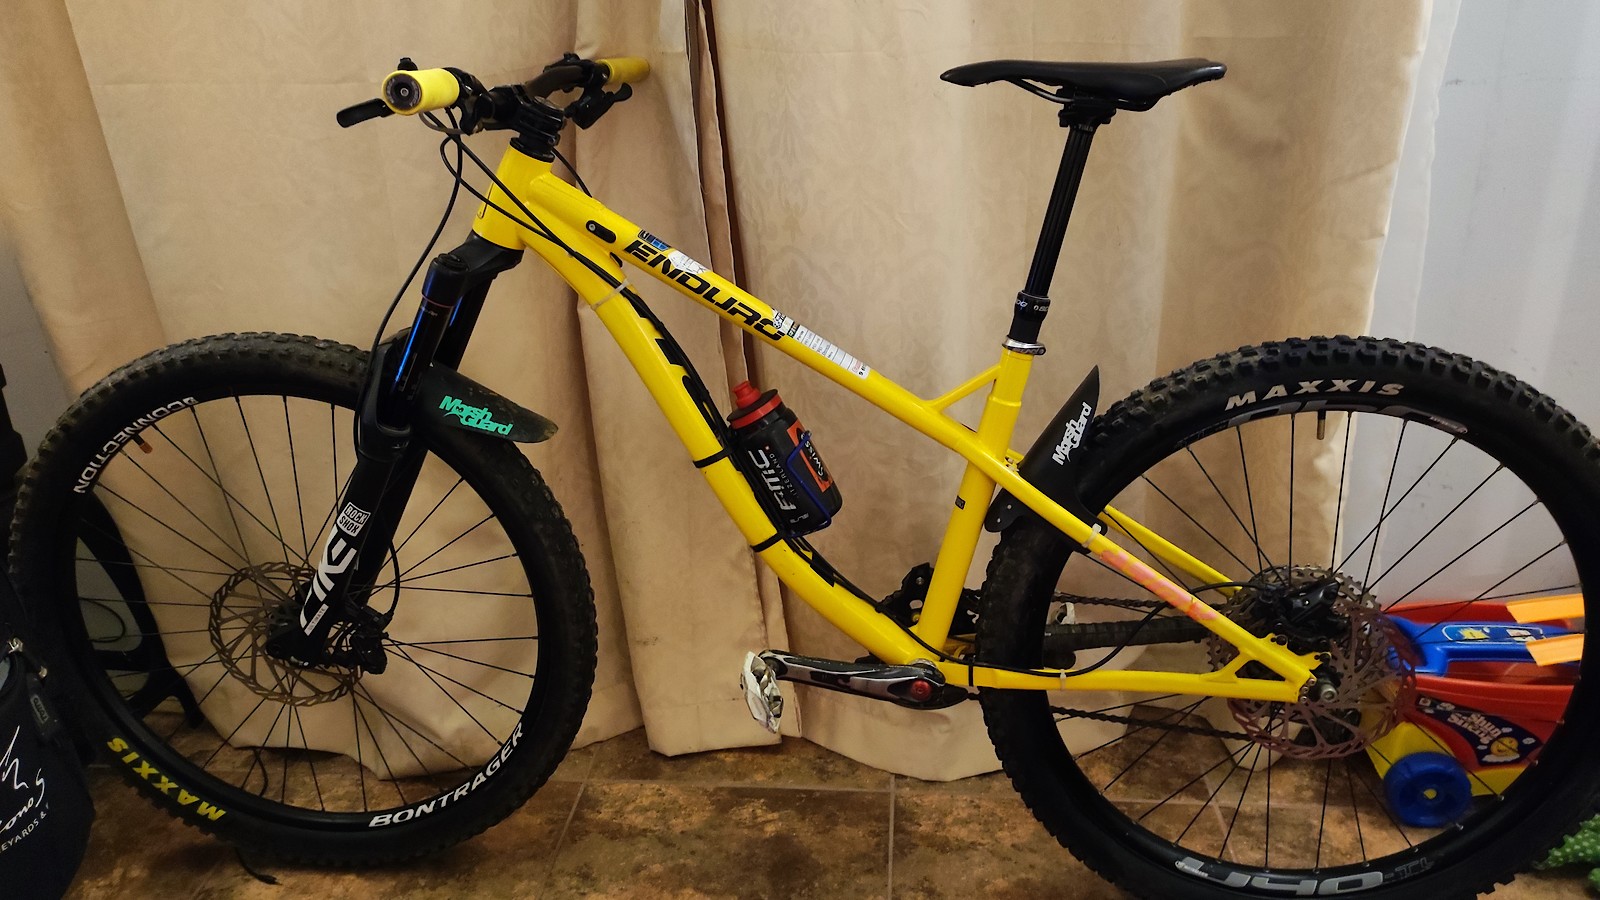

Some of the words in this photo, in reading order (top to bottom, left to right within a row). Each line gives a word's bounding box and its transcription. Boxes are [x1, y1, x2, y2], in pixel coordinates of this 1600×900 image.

[623, 239, 786, 341] ENDURO
[438, 395, 493, 420] Marsh
[1224, 379, 1405, 411] MAXXIS
[458, 414, 514, 436] Guard
[1051, 418, 1078, 466] Marsh
[1070, 401, 1093, 450] Guard
[72, 400, 186, 494] CONNECTION
[339, 515, 360, 534] SHOX
[345, 505, 368, 524] ROCK
[106, 737, 227, 821] MAXXIS
[367, 721, 524, 828] BONTRAGER
[0, 819, 39, 852] EYARDS
